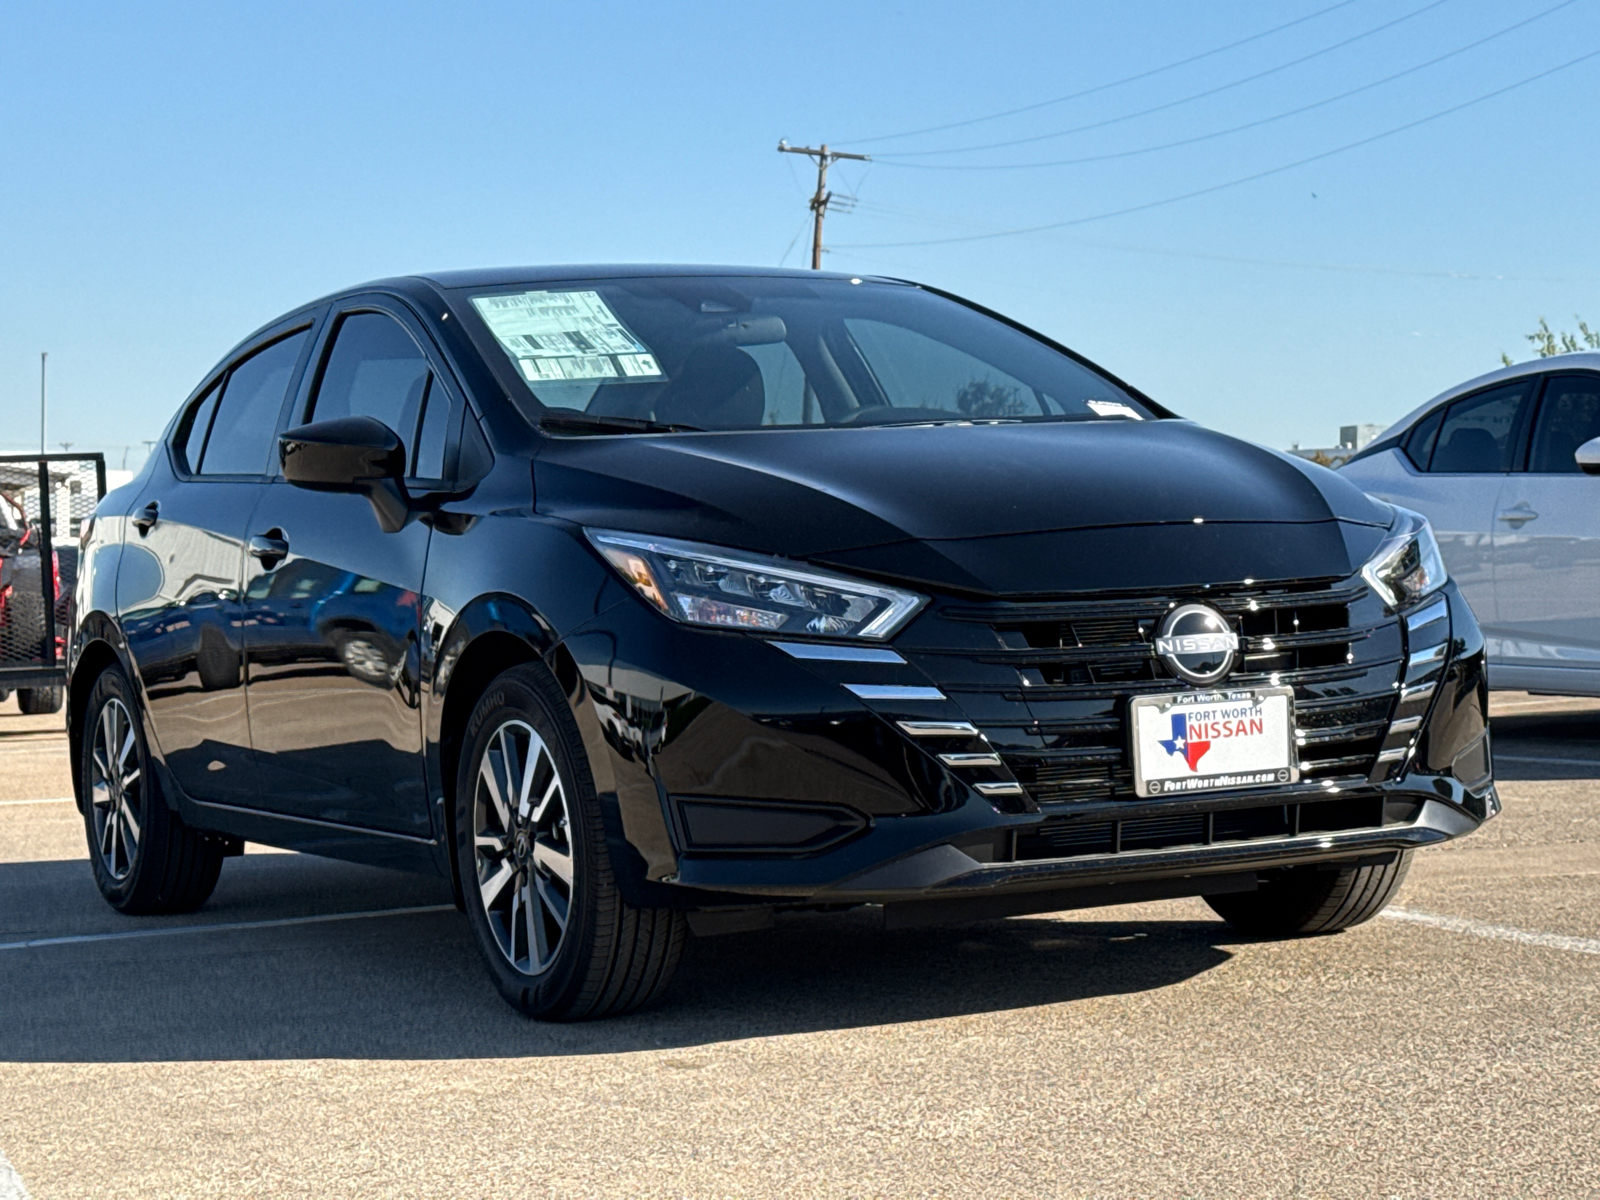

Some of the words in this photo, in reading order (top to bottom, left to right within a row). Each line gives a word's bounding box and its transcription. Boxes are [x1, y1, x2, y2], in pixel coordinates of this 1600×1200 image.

[1158, 636, 1237, 653] NISSAN
[1177, 695, 1195, 704] Fort
[1227, 692, 1251, 700] Texas
[470, 690, 505, 738] KUMHO
[1188, 710, 1218, 722] FORT
[1220, 707, 1262, 720] WORTH
[1188, 718, 1263, 740] NISSAN
